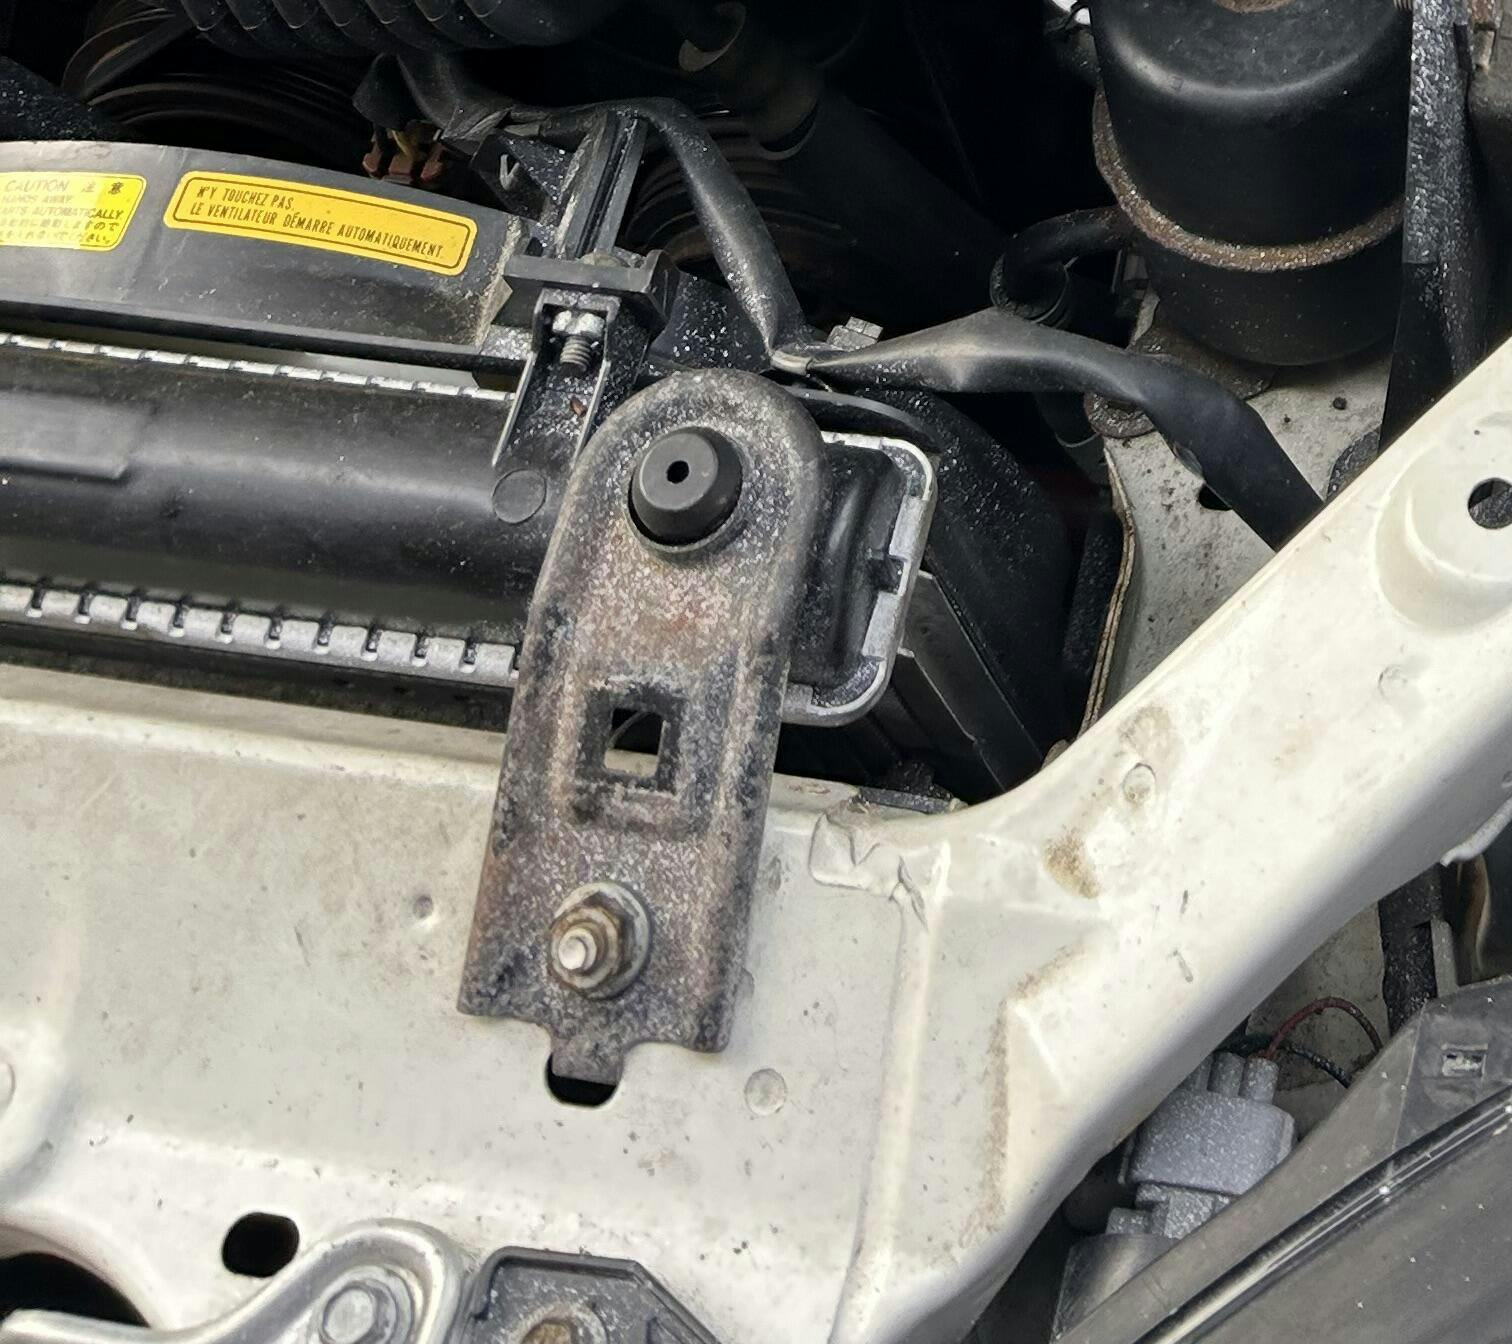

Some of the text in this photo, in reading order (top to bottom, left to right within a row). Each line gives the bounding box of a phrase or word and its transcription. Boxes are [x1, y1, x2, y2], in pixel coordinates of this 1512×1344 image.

[222, 187, 267, 208] TOUCHEZ
[31, 207, 125, 220] AUTOMATICALLY
[190, 202, 444, 259] LE VENTILATEUR DÉMARRE AUTOMATIQUEMENT
